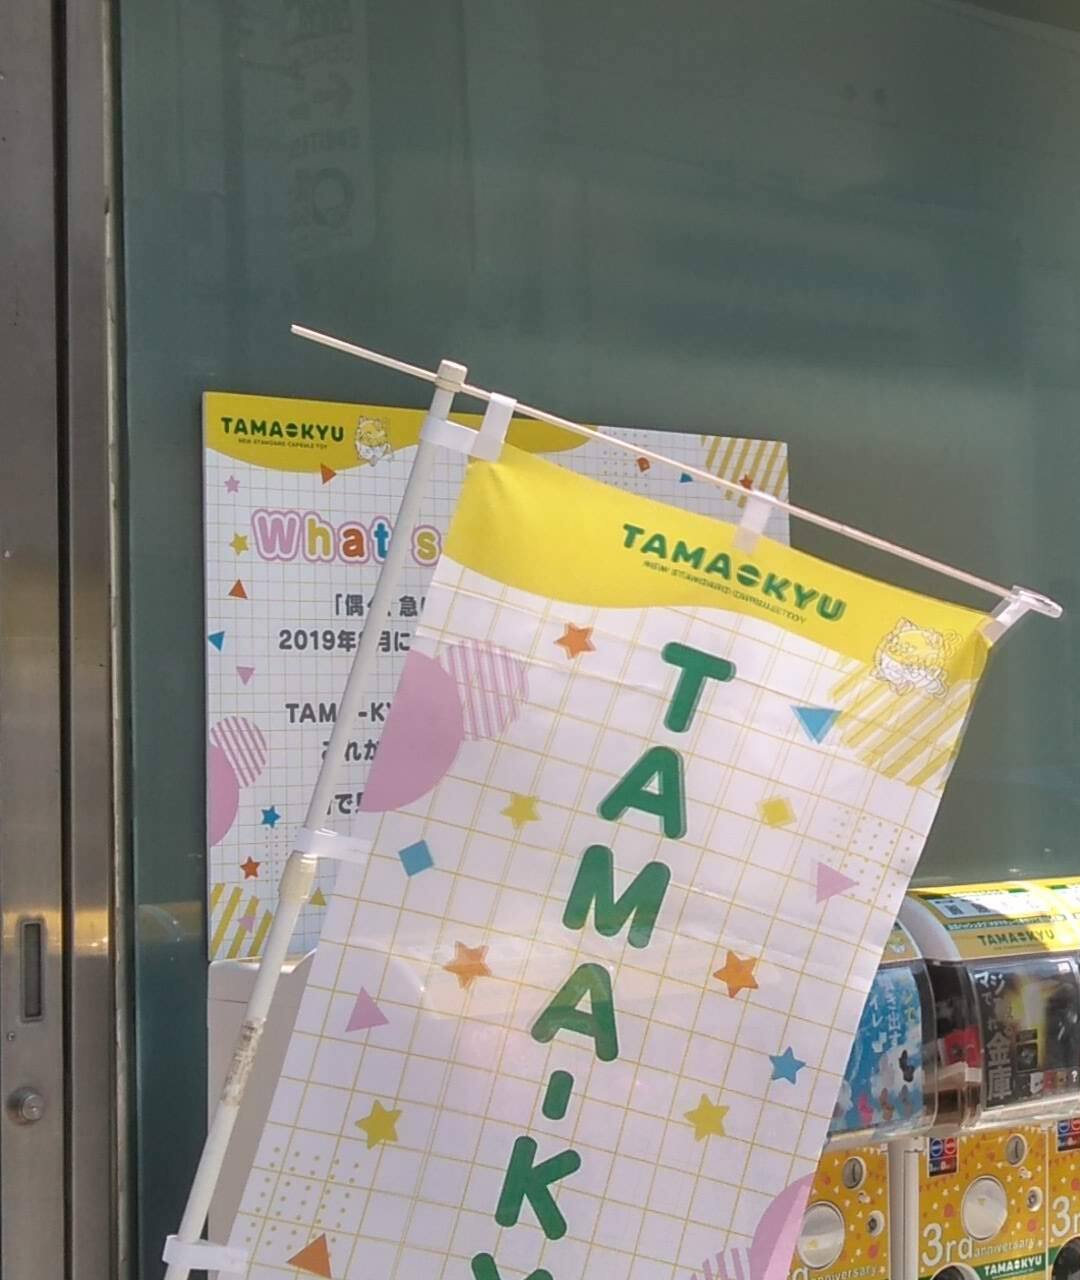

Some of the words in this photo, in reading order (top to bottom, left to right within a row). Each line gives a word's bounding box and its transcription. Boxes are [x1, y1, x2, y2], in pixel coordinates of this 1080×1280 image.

[279, 629, 411, 653] 2019年月に
[285, 702, 391, 723] TAM-K
[921, 1222, 974, 1267] 3rd
